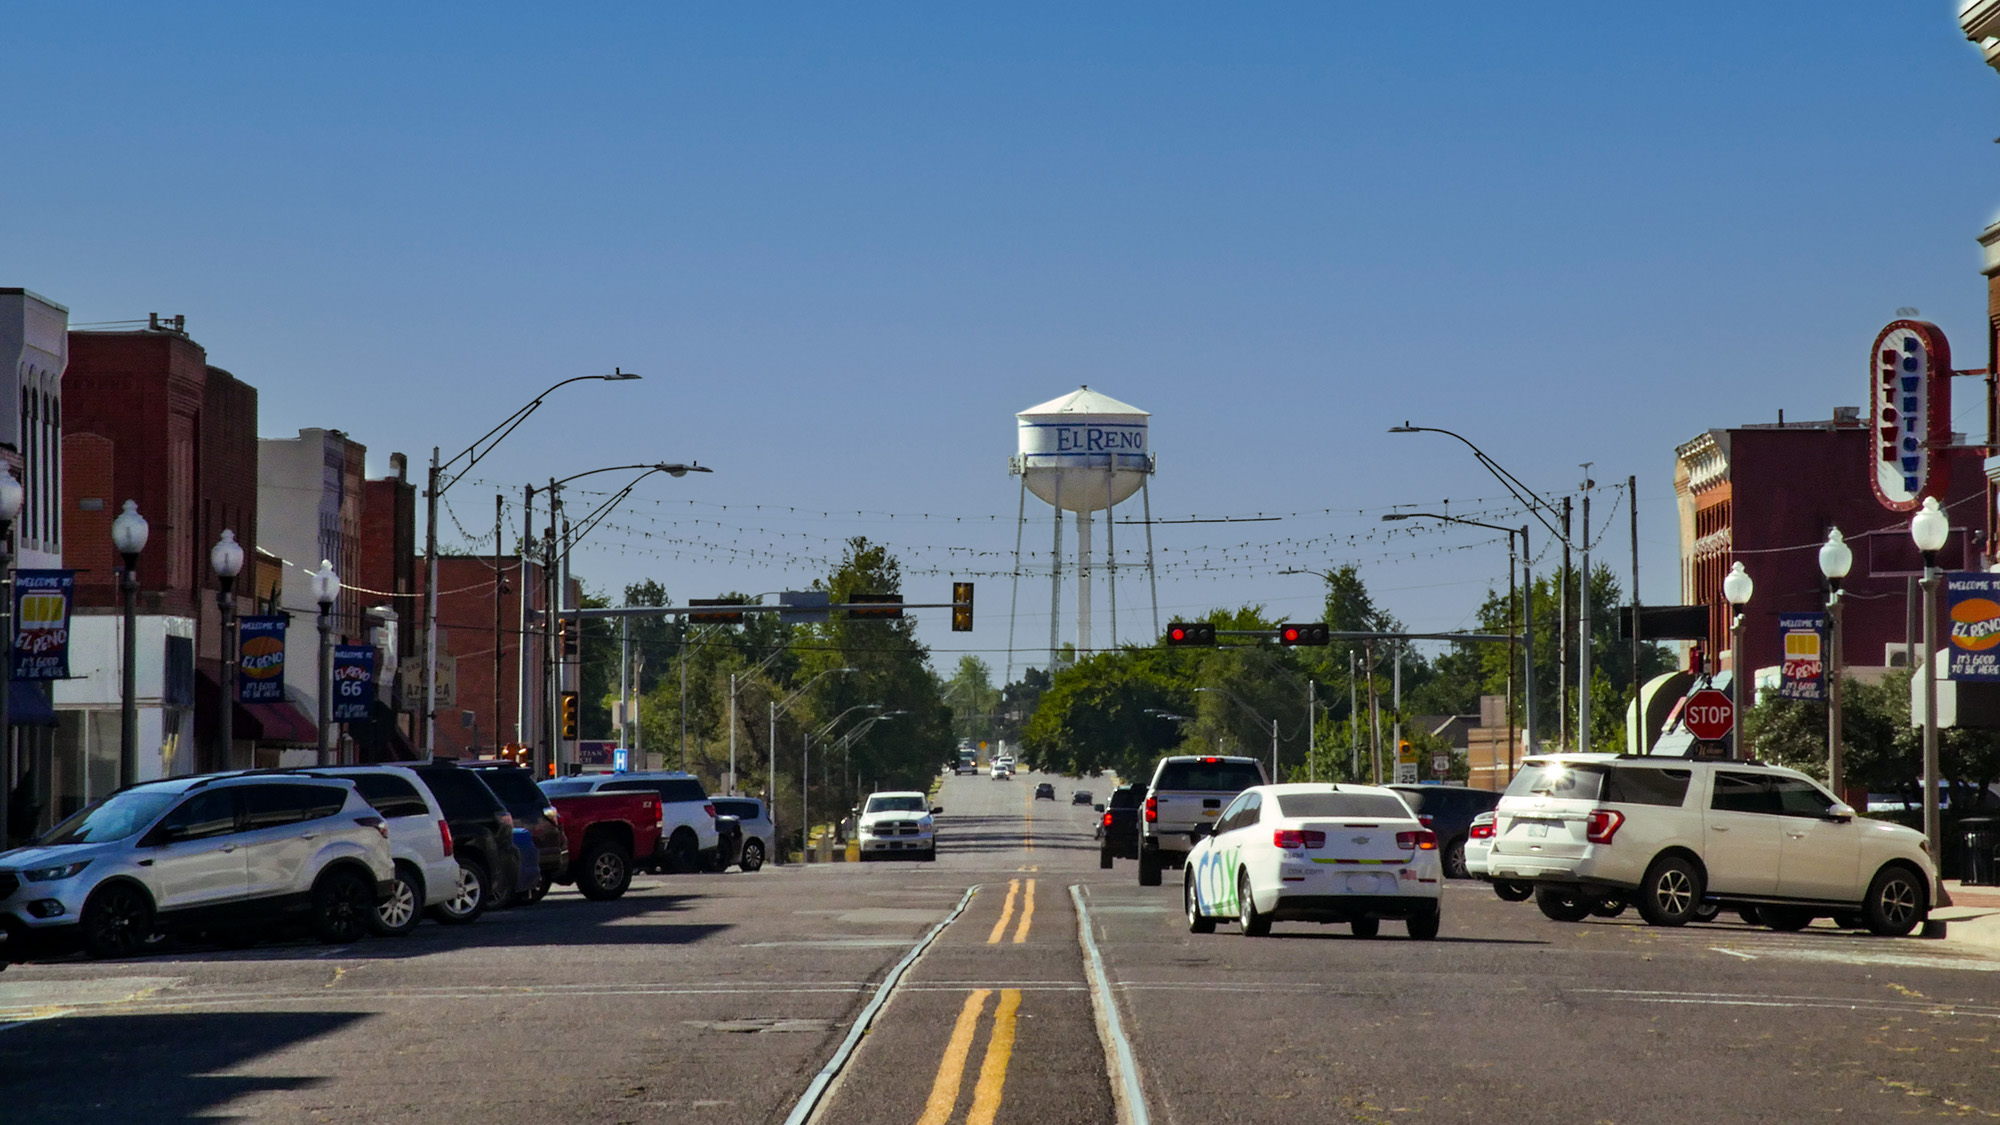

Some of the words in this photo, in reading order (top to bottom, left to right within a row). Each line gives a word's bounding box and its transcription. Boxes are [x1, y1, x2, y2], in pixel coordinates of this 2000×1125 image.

[1881, 350, 1898, 461] UPTOWN
[1901, 337, 1920, 492] DOWNTOWN
[16, 578, 58, 587] WELCOME
[62, 578, 72, 587] TO
[1949, 581, 1989, 590] WELCOME
[241, 622, 273, 630] WELCOME
[1952, 621, 1969, 637] EL
[1970, 618, 2000, 637] RENO
[15, 632, 32, 650] EL
[33, 630, 67, 654] RENO
[242, 656, 256, 669] EL
[1957, 654, 1970, 664] IT'S
[1973, 655, 1995, 664] GOOD
[335, 667, 347, 680] EL
[1782, 662, 1795, 676] EL
[1796, 662, 1822, 679] RENO
[1952, 665, 1963, 673] TO
[1965, 665, 1976, 674] BE
[1978, 665, 2000, 675] HERE
[341, 681, 362, 696] 66
[1798, 682, 1817, 690] GOOD
[1689, 706, 1731, 724] STOP
[616, 752, 625, 770] H
[1401, 775, 1416, 784] 25
[1198, 849, 1240, 917] COX
